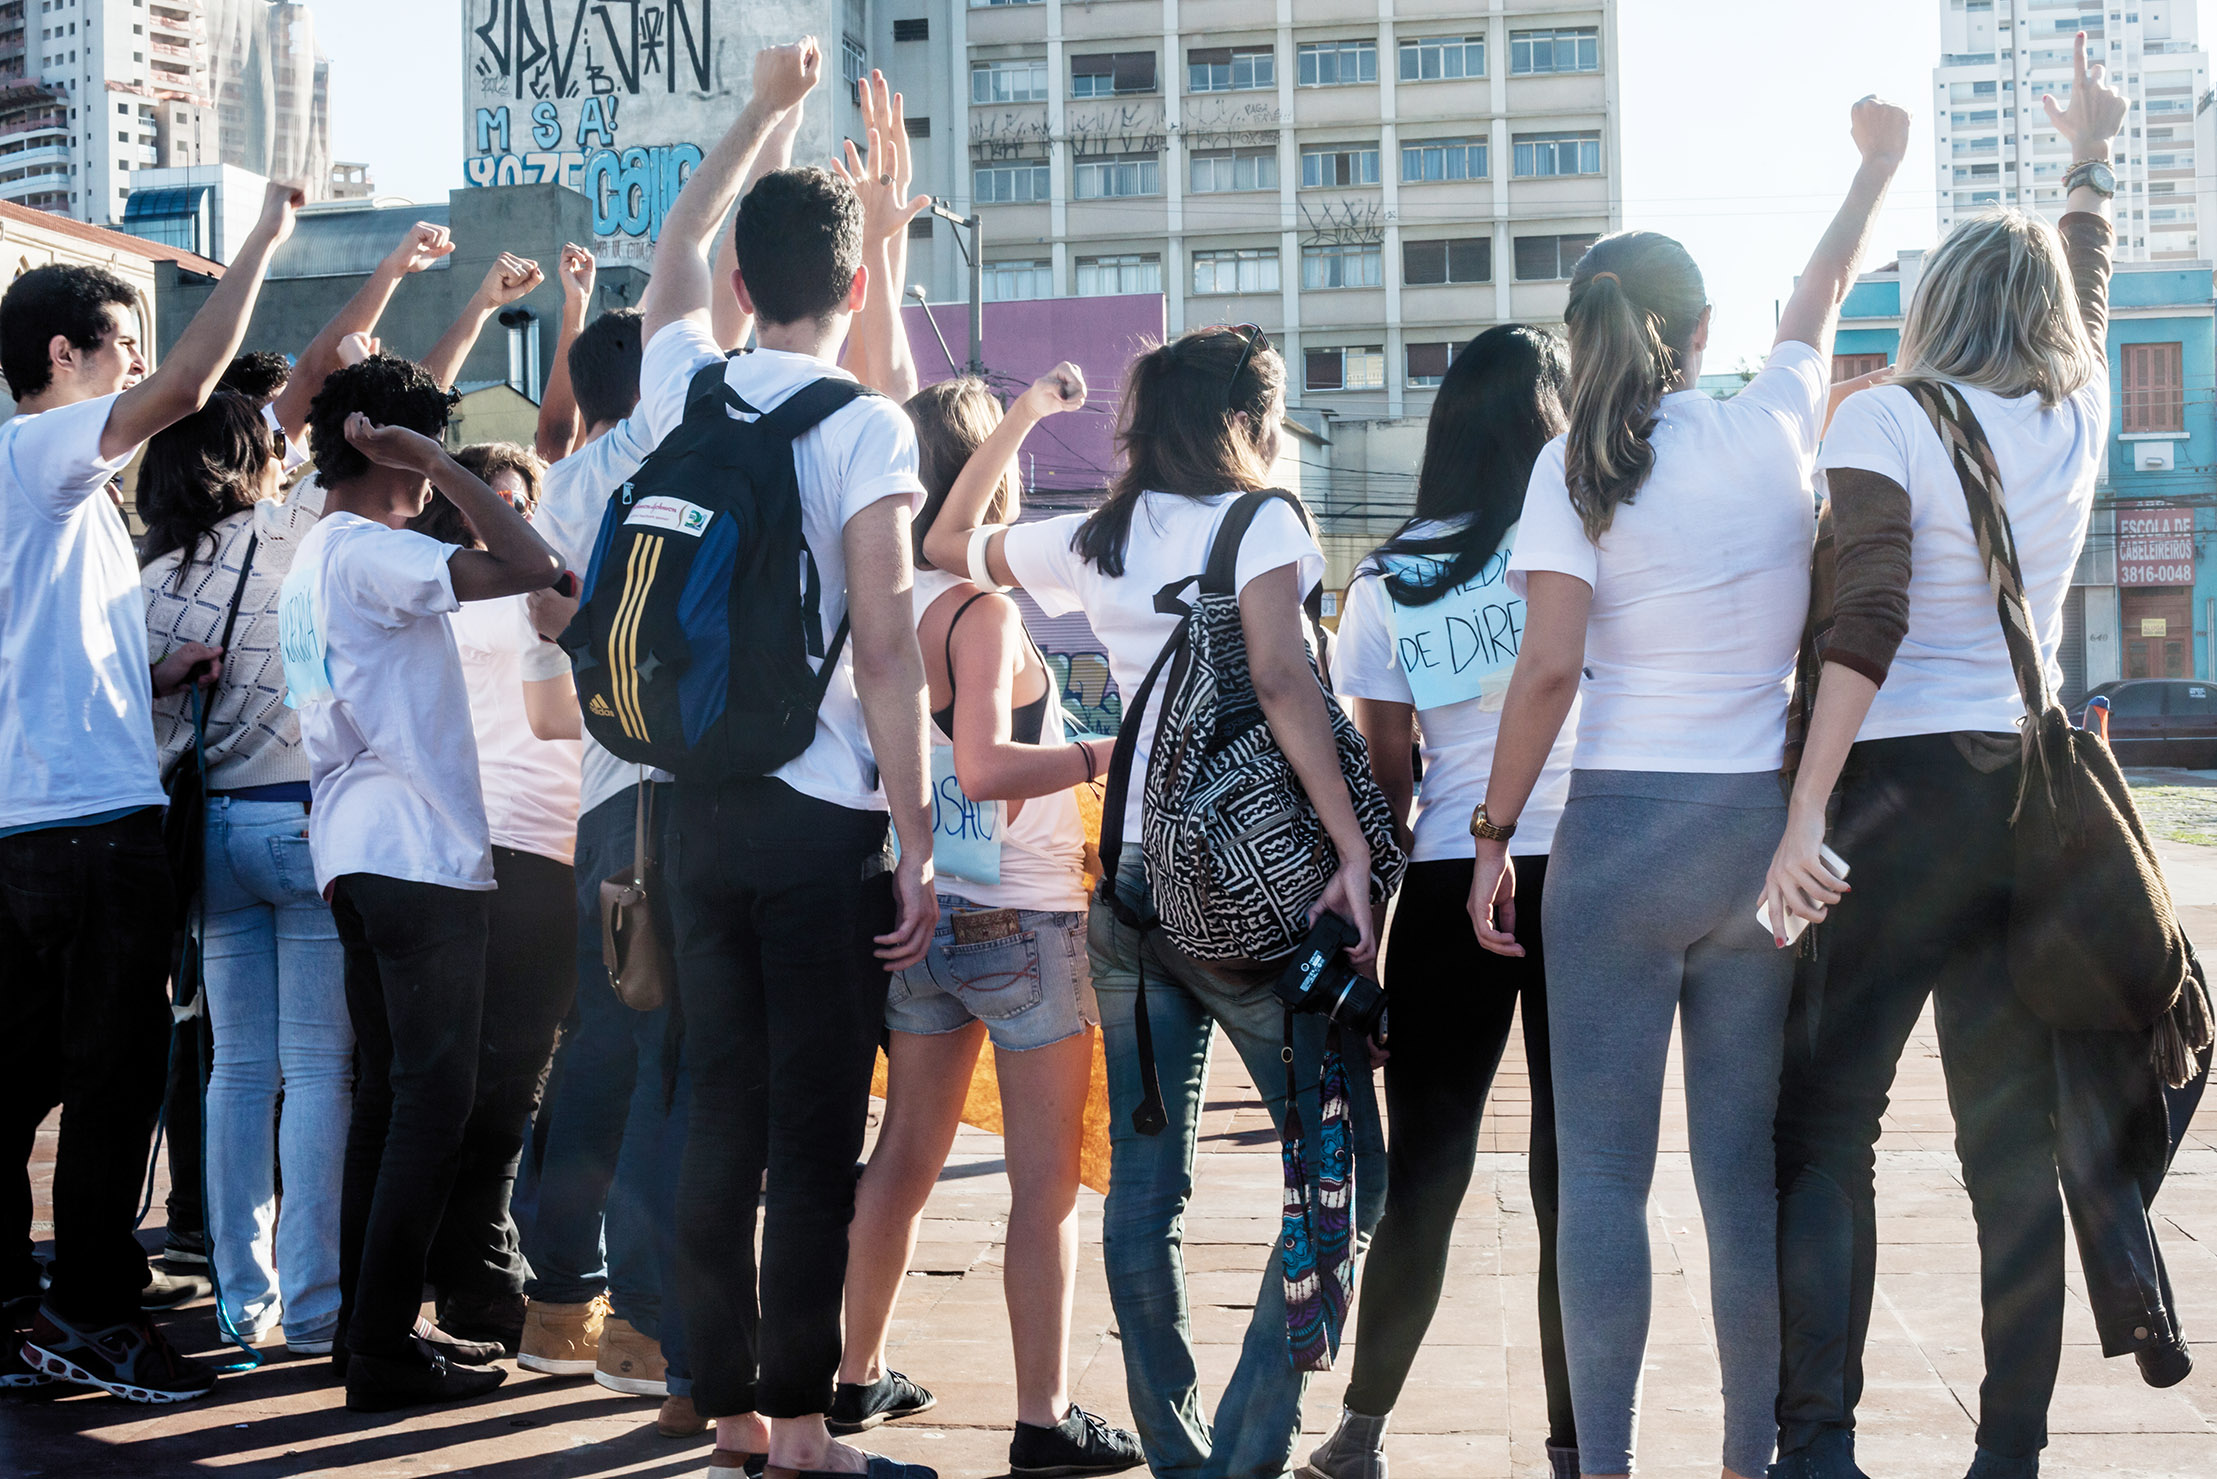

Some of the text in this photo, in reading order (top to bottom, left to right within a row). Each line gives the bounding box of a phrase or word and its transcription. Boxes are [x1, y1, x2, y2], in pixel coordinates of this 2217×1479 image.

[2121, 517, 2191, 539] ESCOLA DE
[2119, 539, 2192, 561] CABELEIREIROS
[2121, 564, 2191, 583] 3816-0048
[1399, 600, 1527, 674] DE DiRE
